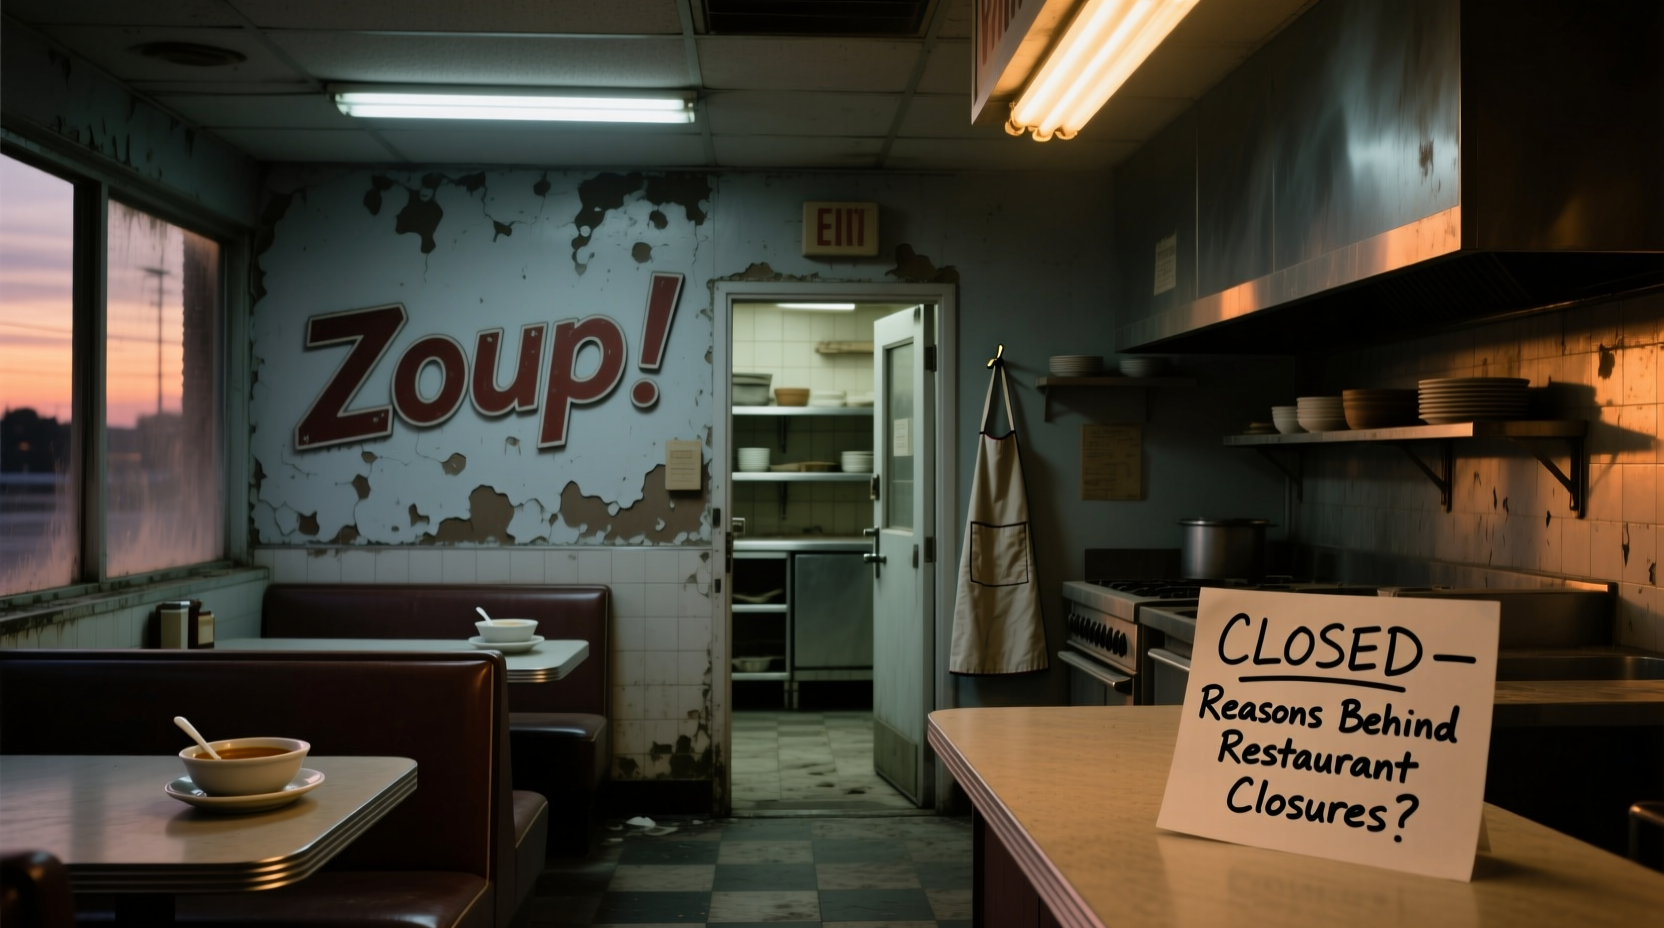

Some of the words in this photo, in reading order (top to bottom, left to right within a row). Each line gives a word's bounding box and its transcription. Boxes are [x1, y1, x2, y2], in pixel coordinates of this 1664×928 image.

[294, 271, 685, 450] Zoup!
[1199, 684, 1323, 729] Reasons
[1338, 698, 1460, 744] Behind
[1217, 728, 1420, 784] Restaurant
[1226, 776, 1420, 843] Closures?
